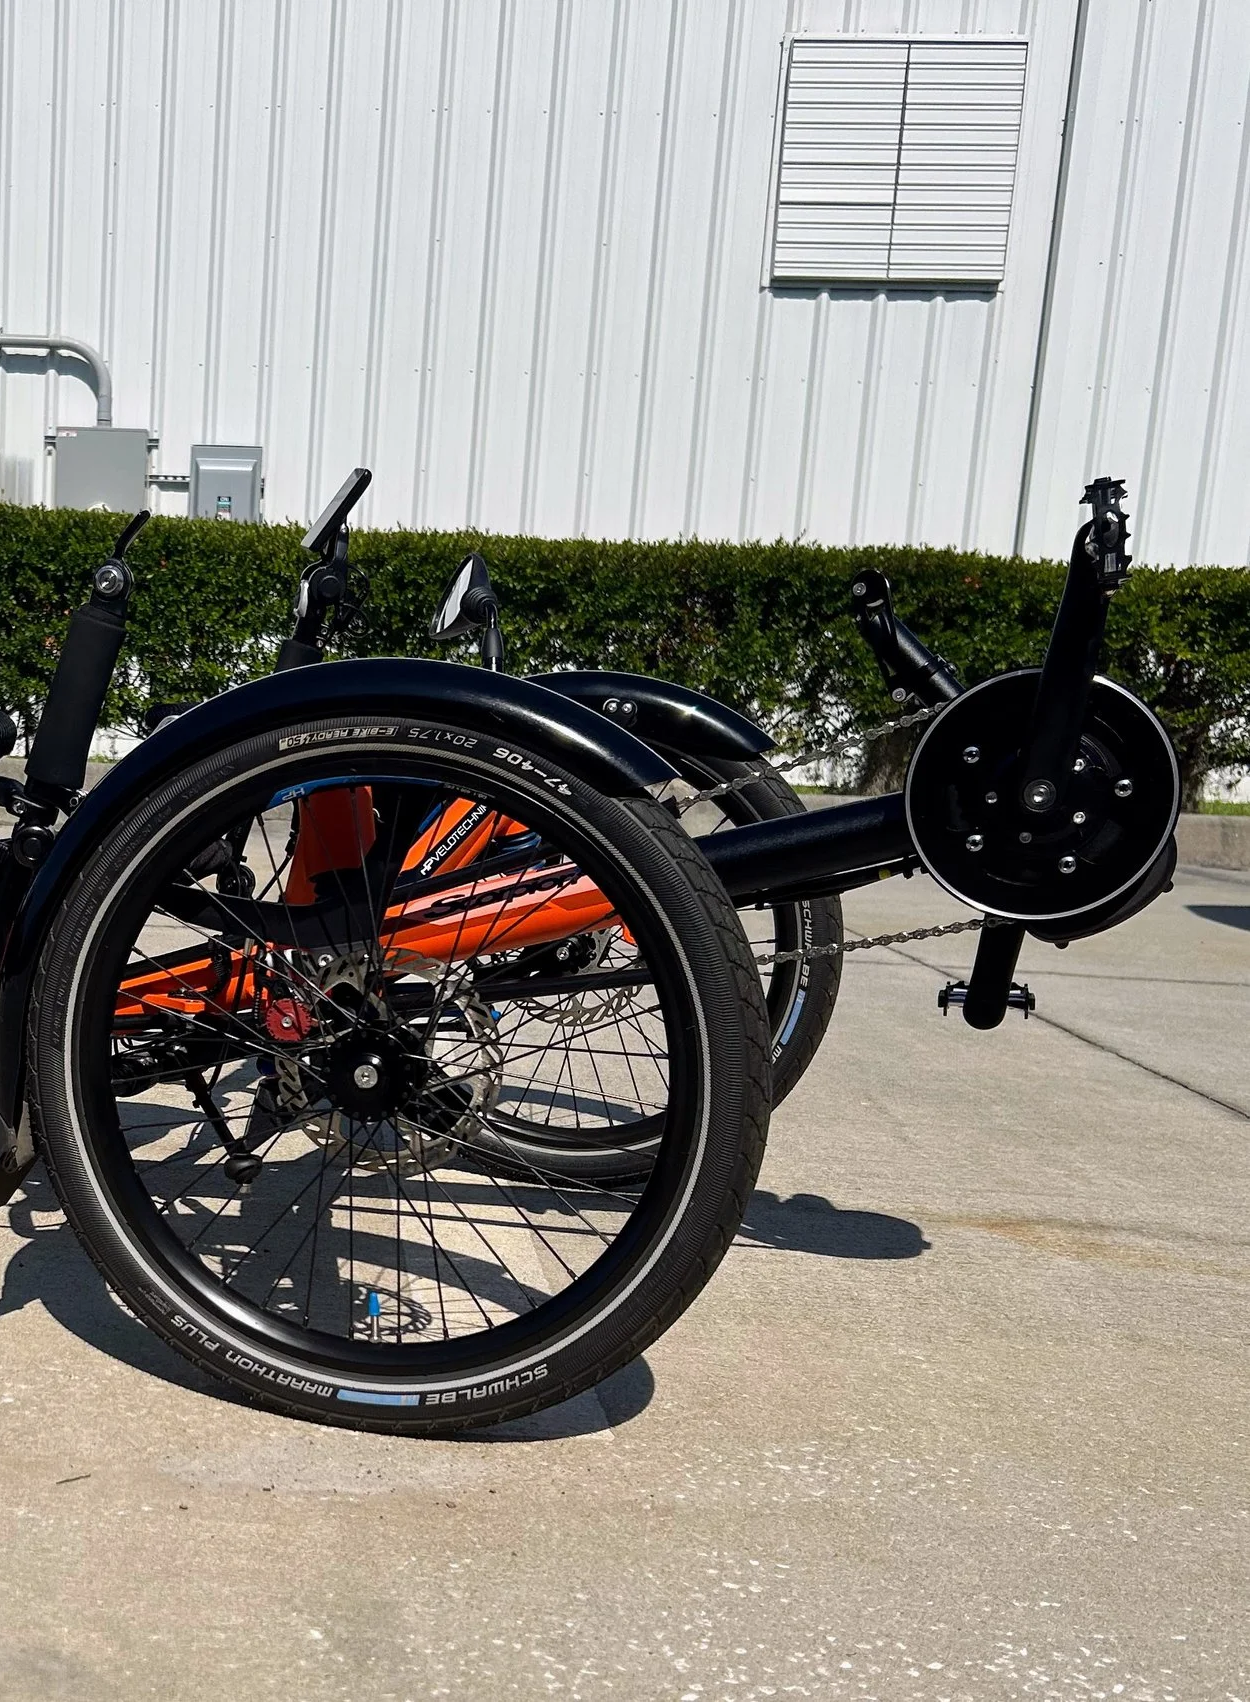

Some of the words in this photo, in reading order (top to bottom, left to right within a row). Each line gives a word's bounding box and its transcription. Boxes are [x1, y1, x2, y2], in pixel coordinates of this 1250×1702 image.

[311, 729, 349, 740] READY
[353, 727, 394, 737] E-BIKE
[407, 727, 478, 749] 20x1.75
[493, 747, 572, 796] 47-406
[170, 1314, 221, 1351] PLUS
[225, 1349, 334, 1398] MARATHON
[425, 1363, 548, 1406] SCHWALBE
